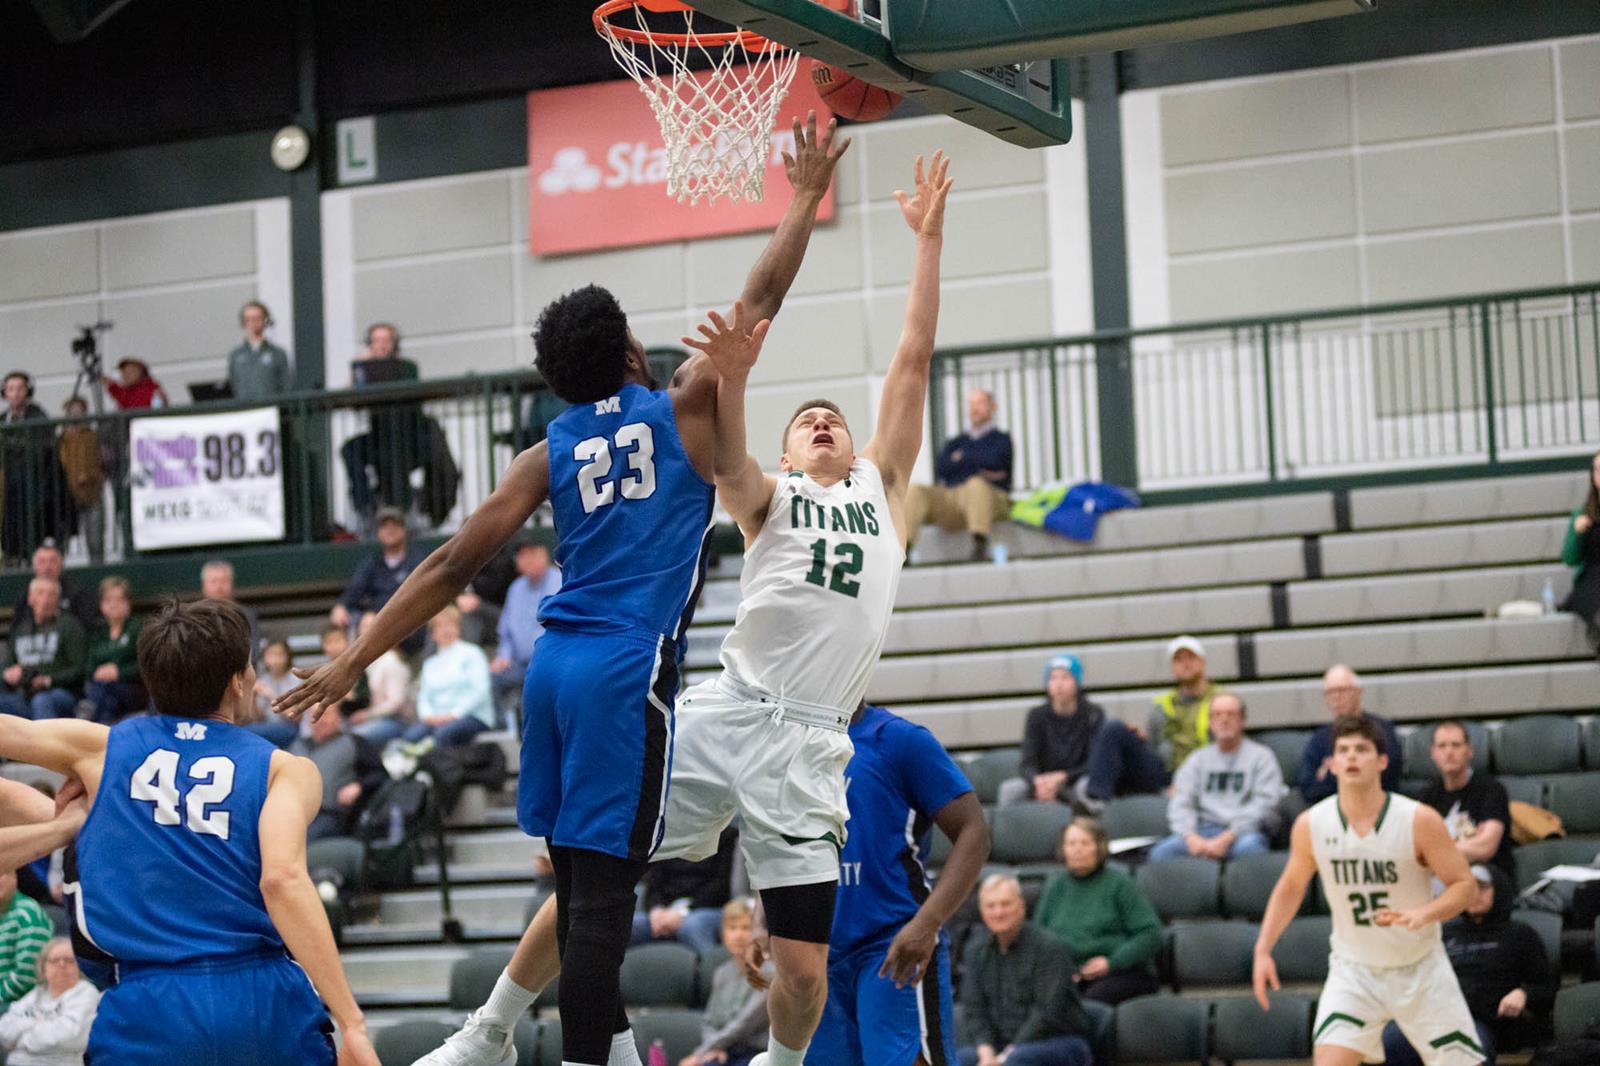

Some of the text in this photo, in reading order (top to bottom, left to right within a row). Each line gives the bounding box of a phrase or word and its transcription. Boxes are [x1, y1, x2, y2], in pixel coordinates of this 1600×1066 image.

[346, 130, 367, 168] L
[594, 396, 621, 416] M
[204, 430, 278, 482] 98.3
[573, 422, 656, 514] 23
[791, 495, 879, 536] TITANS
[805, 538, 864, 598] 12
[174, 722, 208, 740] M
[130, 748, 236, 840] 42
[1330, 859, 1398, 885] TITANS
